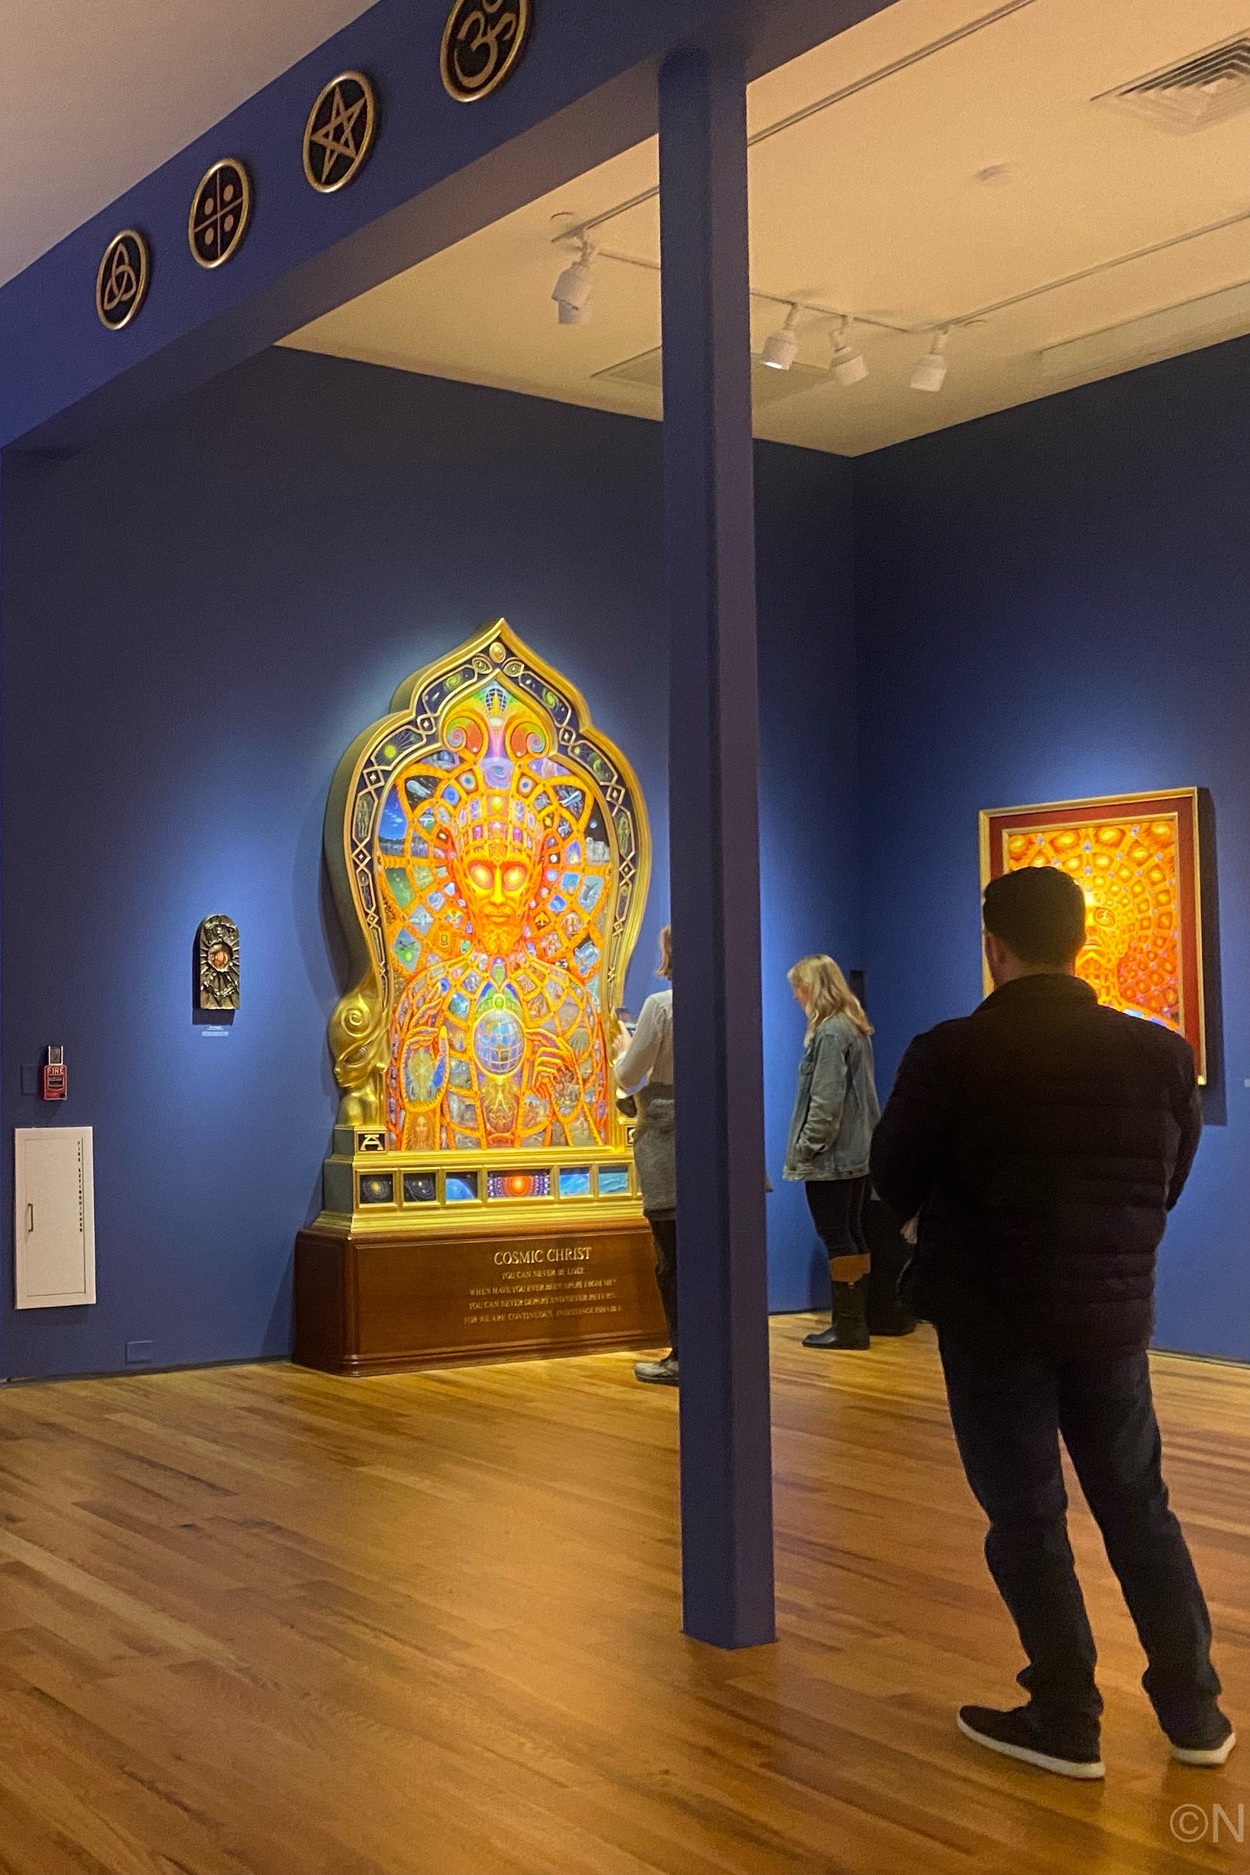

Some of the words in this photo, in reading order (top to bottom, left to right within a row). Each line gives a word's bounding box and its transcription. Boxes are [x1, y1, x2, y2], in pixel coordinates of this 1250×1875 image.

[47, 1066, 64, 1075] FIRE
[494, 1250, 543, 1265] COSMIC
[547, 1247, 592, 1262] CHRIST
[502, 1272, 516, 1280] YOU
[516, 1271, 531, 1279] CAN
[533, 1269, 556, 1278] NEVER
[470, 1287, 491, 1296] WHEN
[492, 1286, 511, 1295] HAVE
[512, 1285, 526, 1294] YOU
[469, 1302, 483, 1310] YOU
[484, 1301, 500, 1309] CAN
[501, 1299, 523, 1308] NEVER
